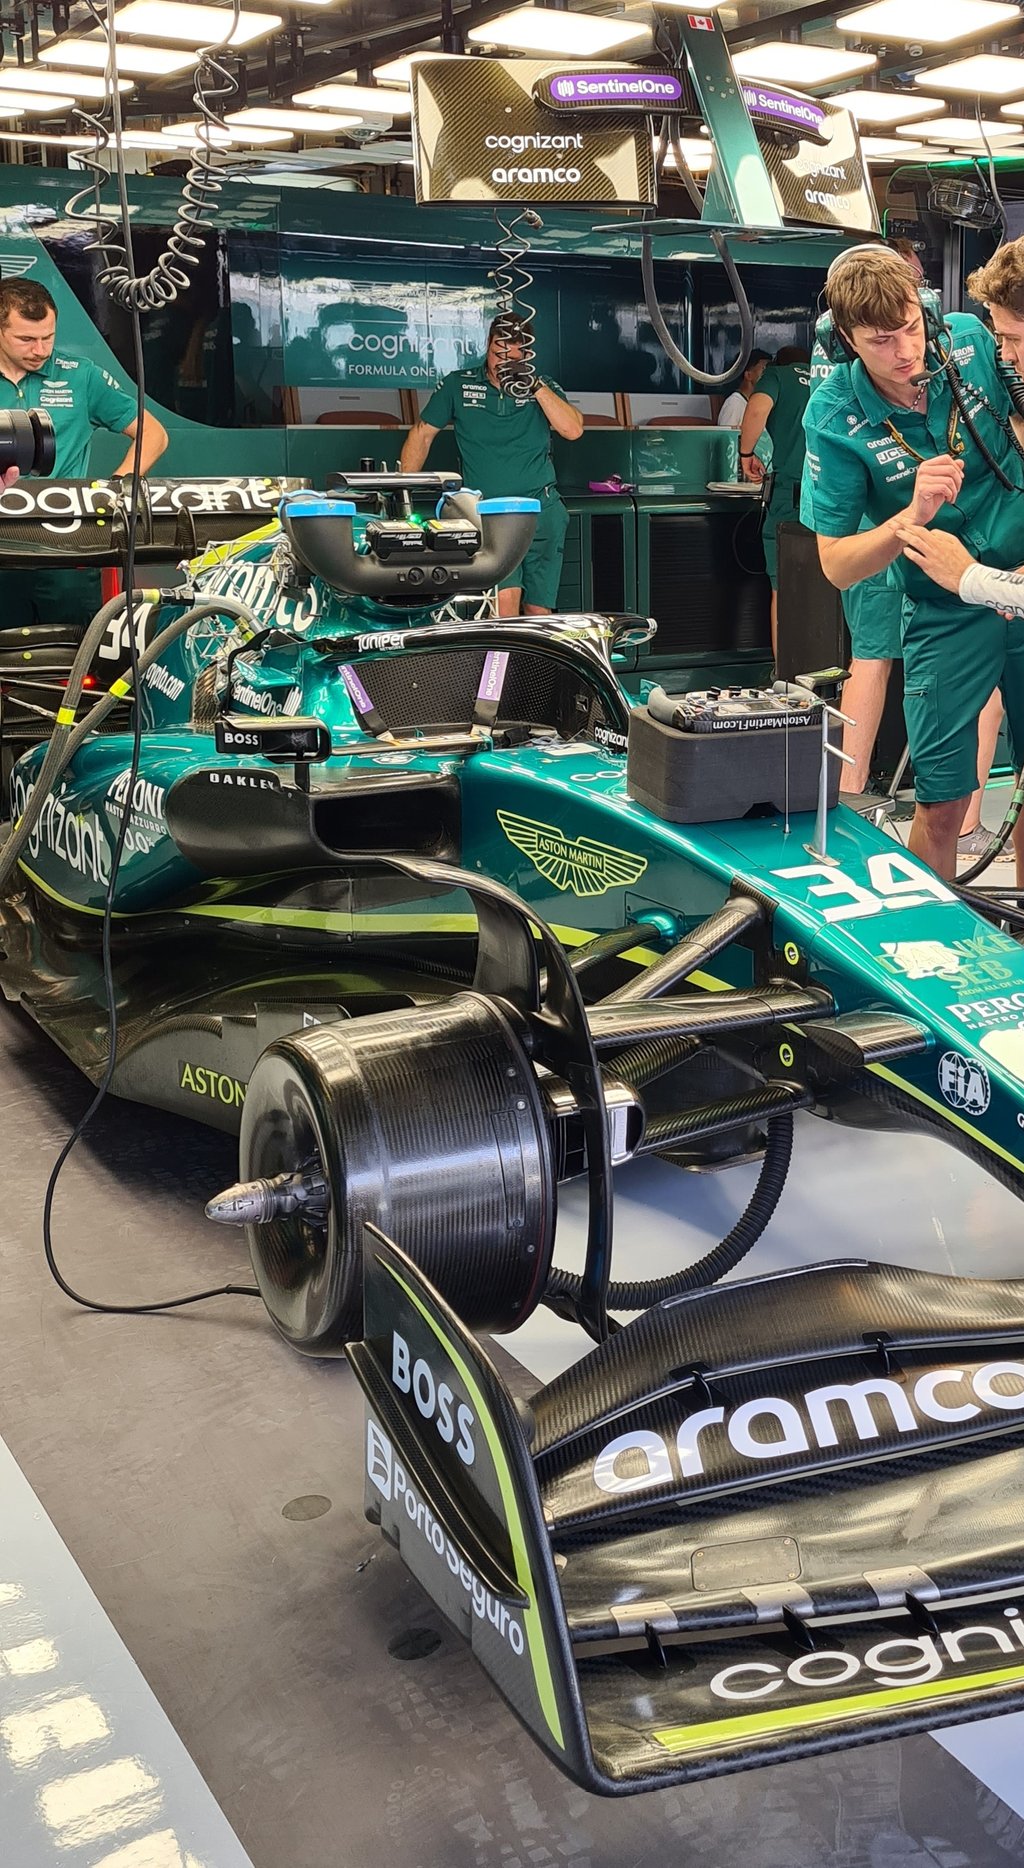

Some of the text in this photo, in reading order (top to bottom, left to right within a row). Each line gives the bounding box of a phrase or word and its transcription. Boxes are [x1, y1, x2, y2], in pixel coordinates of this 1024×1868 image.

[576, 79, 675, 96] SentinelOne
[758, 94, 824, 125] SentinelOne
[485, 132, 584, 154] cognizant
[492, 166, 582, 184] aramco
[796, 158, 846, 181] cognizant
[804, 188, 851, 211] aramco
[348, 332, 473, 359] cognizant
[349, 364, 436, 377] FORMULA ONE
[848, 418, 869, 437] crypto.co
[886, 465, 920, 483] SentinelOn
[146, 663, 186, 702] crypto.com
[712, 715, 812, 731] AstonMartinF1.com
[224, 732, 259, 746] BOSS
[594, 726, 629, 747] cognizan
[208, 771, 276, 791] OAKLEY
[105, 801, 167, 835] NASTR AZZURRO
[538, 836, 604, 870] ASTON MARTIN
[770, 852, 961, 923] 34
[874, 933, 1020, 975] DANKE
[936, 959, 1013, 990] SEB
[957, 987, 982, 997] FROM
[982, 984, 1000, 994] ALL
[966, 1013, 1020, 1030] NASTRO
[181, 1062, 249, 1107] ASTON
[391, 1330, 476, 1466] BOSS
